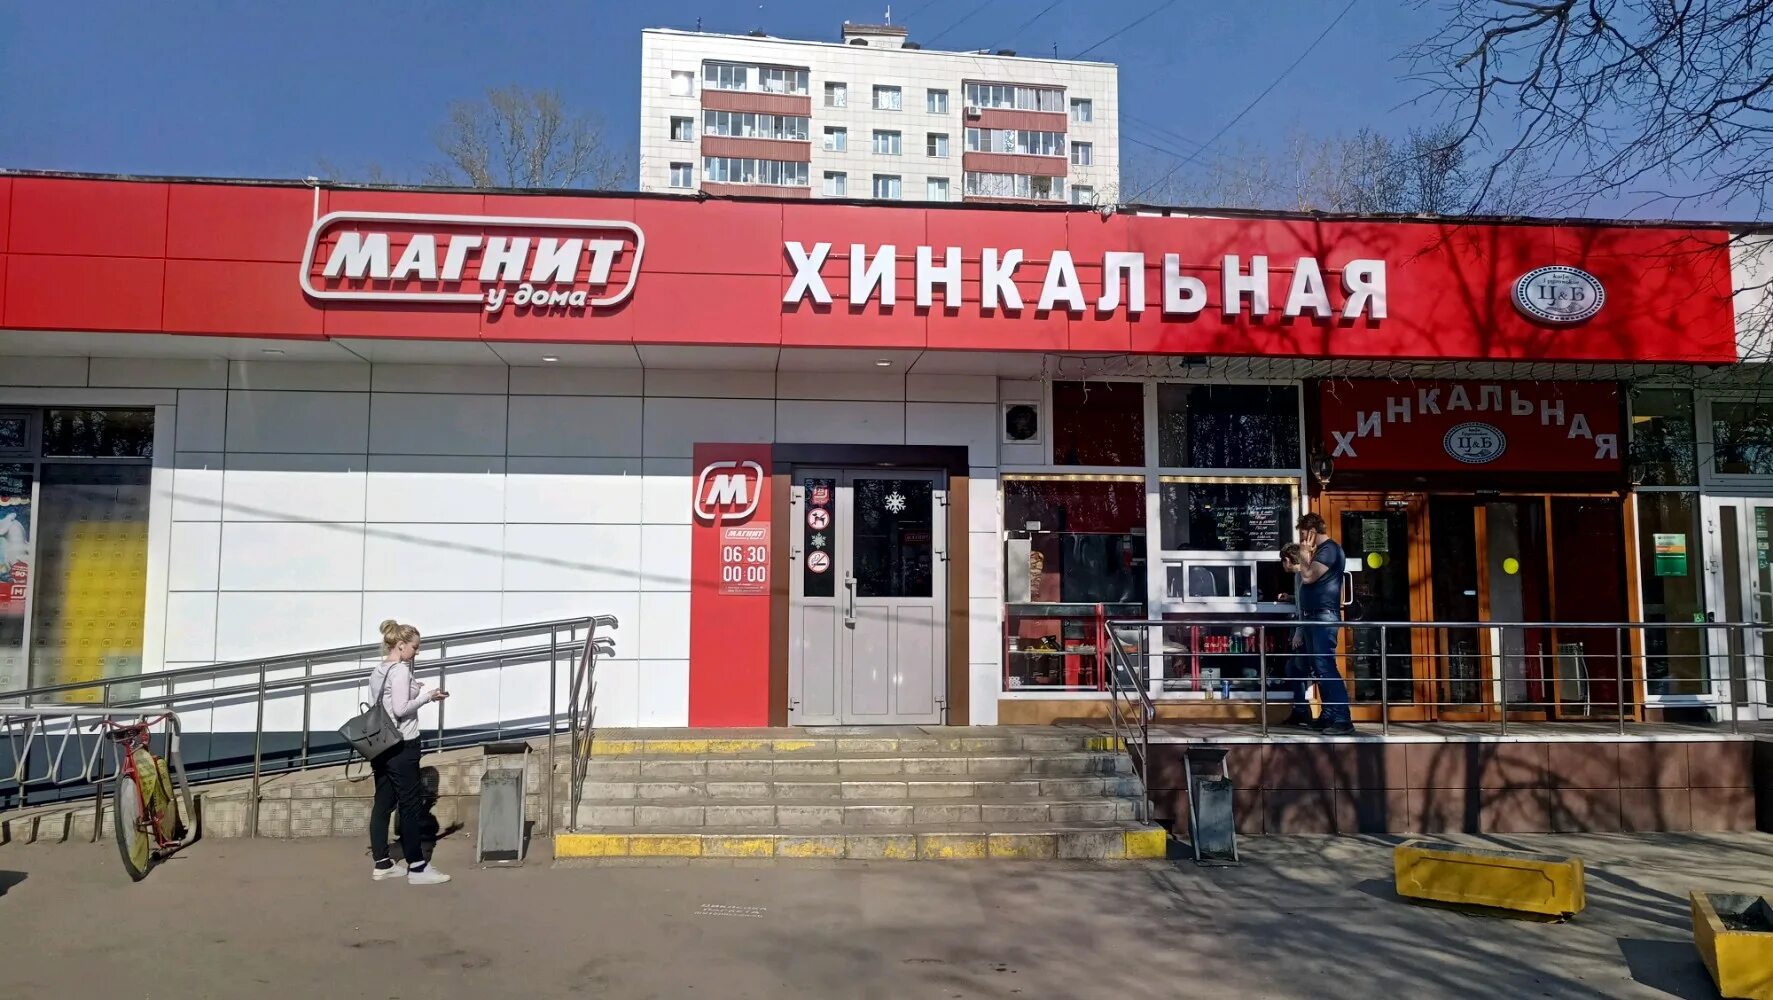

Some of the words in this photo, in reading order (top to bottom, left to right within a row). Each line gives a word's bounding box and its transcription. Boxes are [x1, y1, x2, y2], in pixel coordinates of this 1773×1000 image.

[322, 231, 625, 285] МАГНИТ
[781, 241, 1388, 321] ХИНКАЛЬНАЯ
[485, 288, 506, 312] у
[513, 283, 588, 307] дома
[1331, 385, 1619, 459] ХИНКАЛЬНАЯ
[706, 474, 747, 505] М
